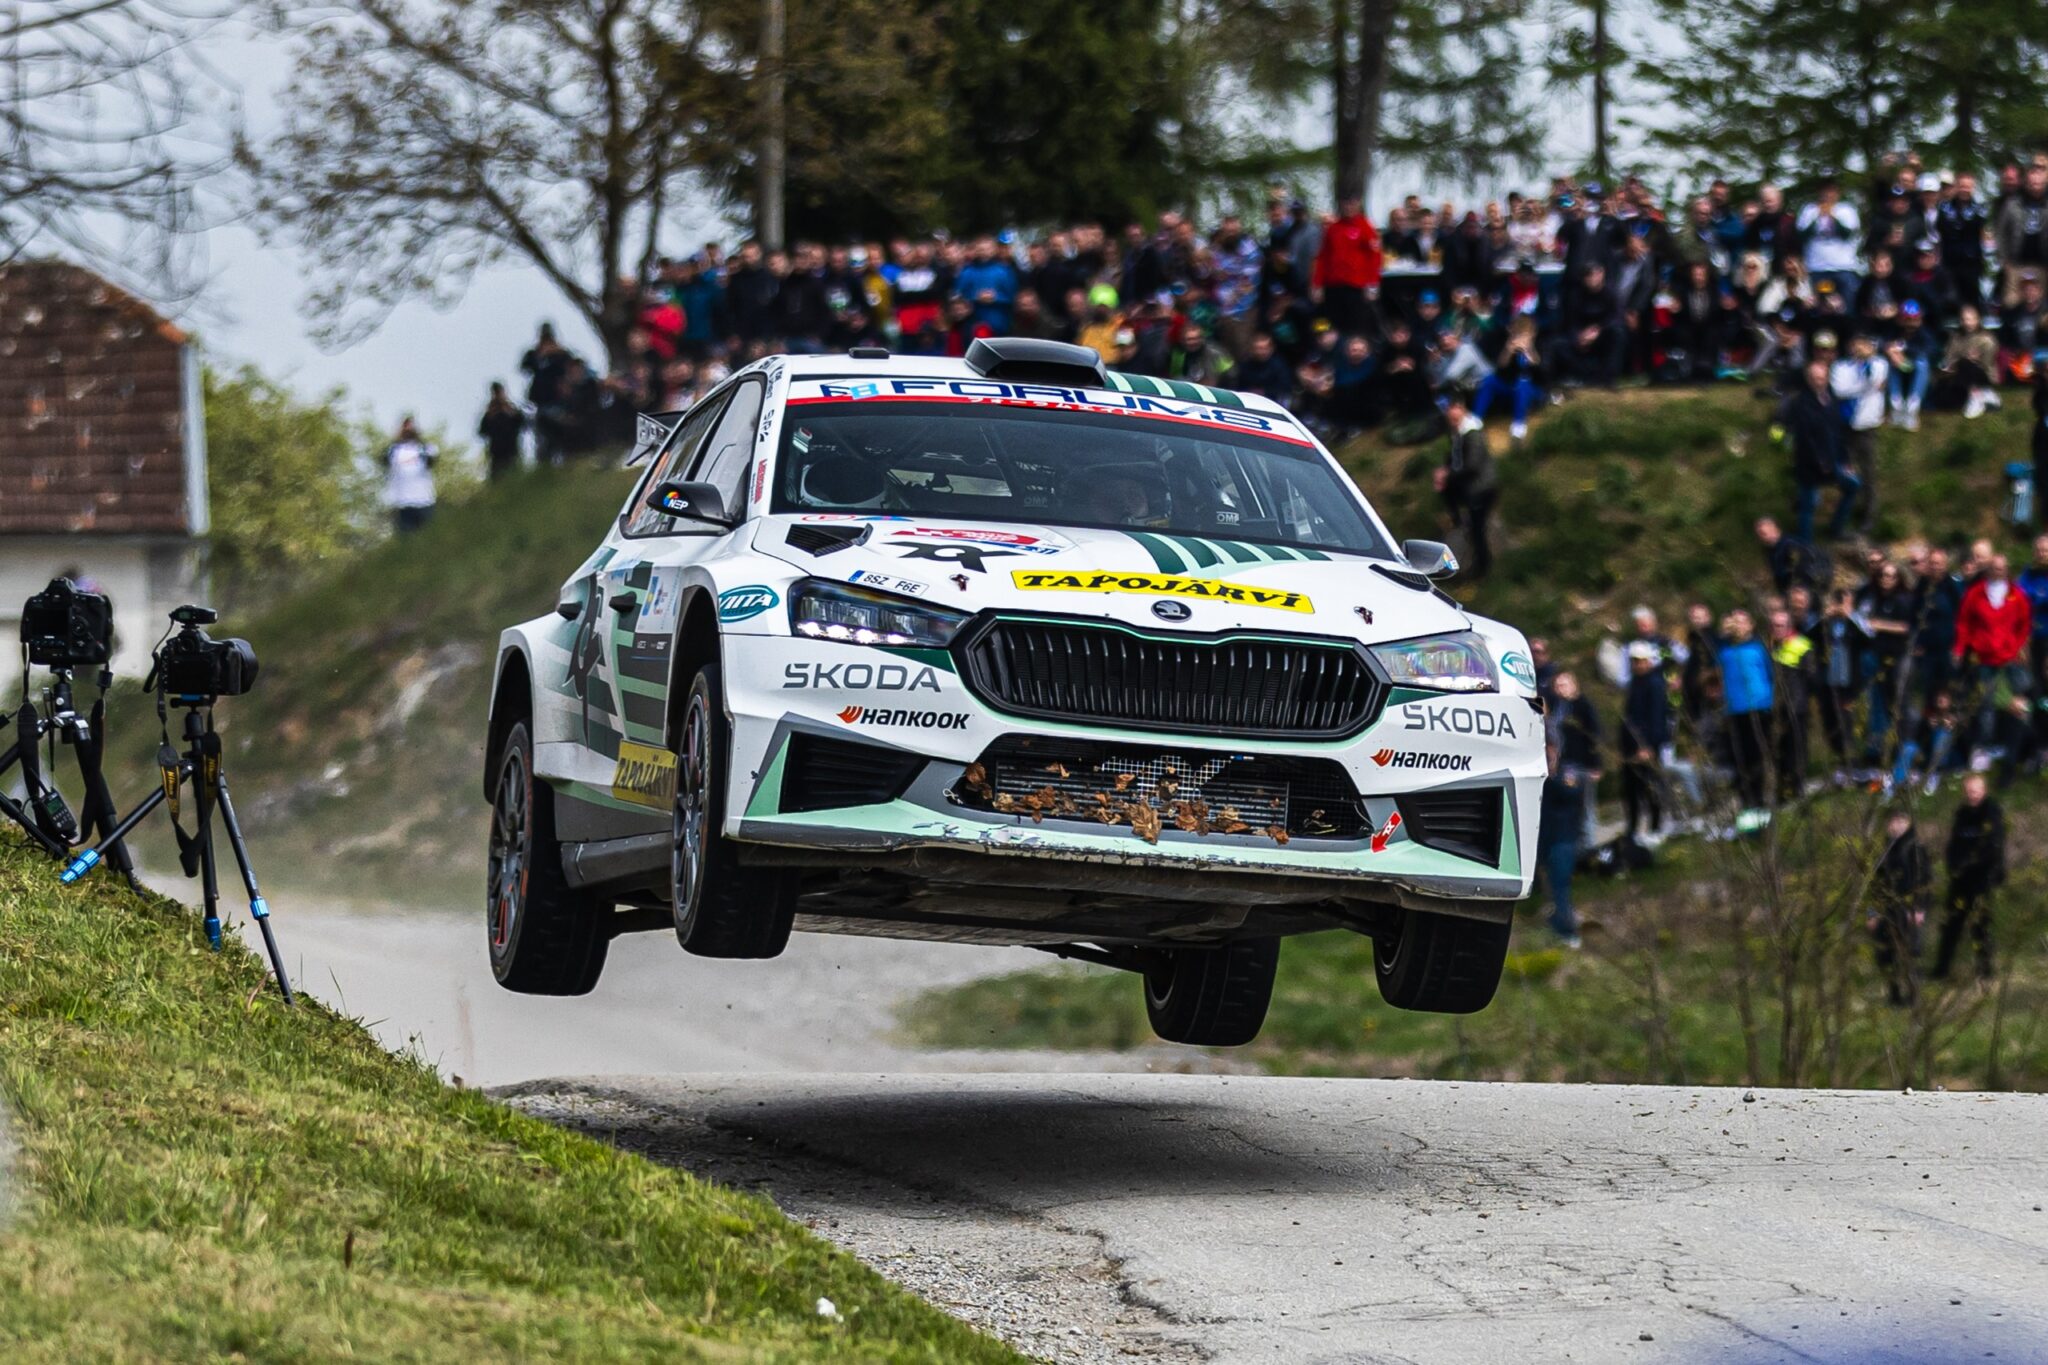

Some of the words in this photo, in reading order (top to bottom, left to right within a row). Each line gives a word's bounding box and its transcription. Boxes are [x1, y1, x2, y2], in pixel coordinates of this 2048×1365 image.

[890, 380, 1273, 431] FORUM8
[667, 498, 689, 510] NEP
[863, 574, 889, 586] 8SZ
[895, 581, 920, 594] F6E
